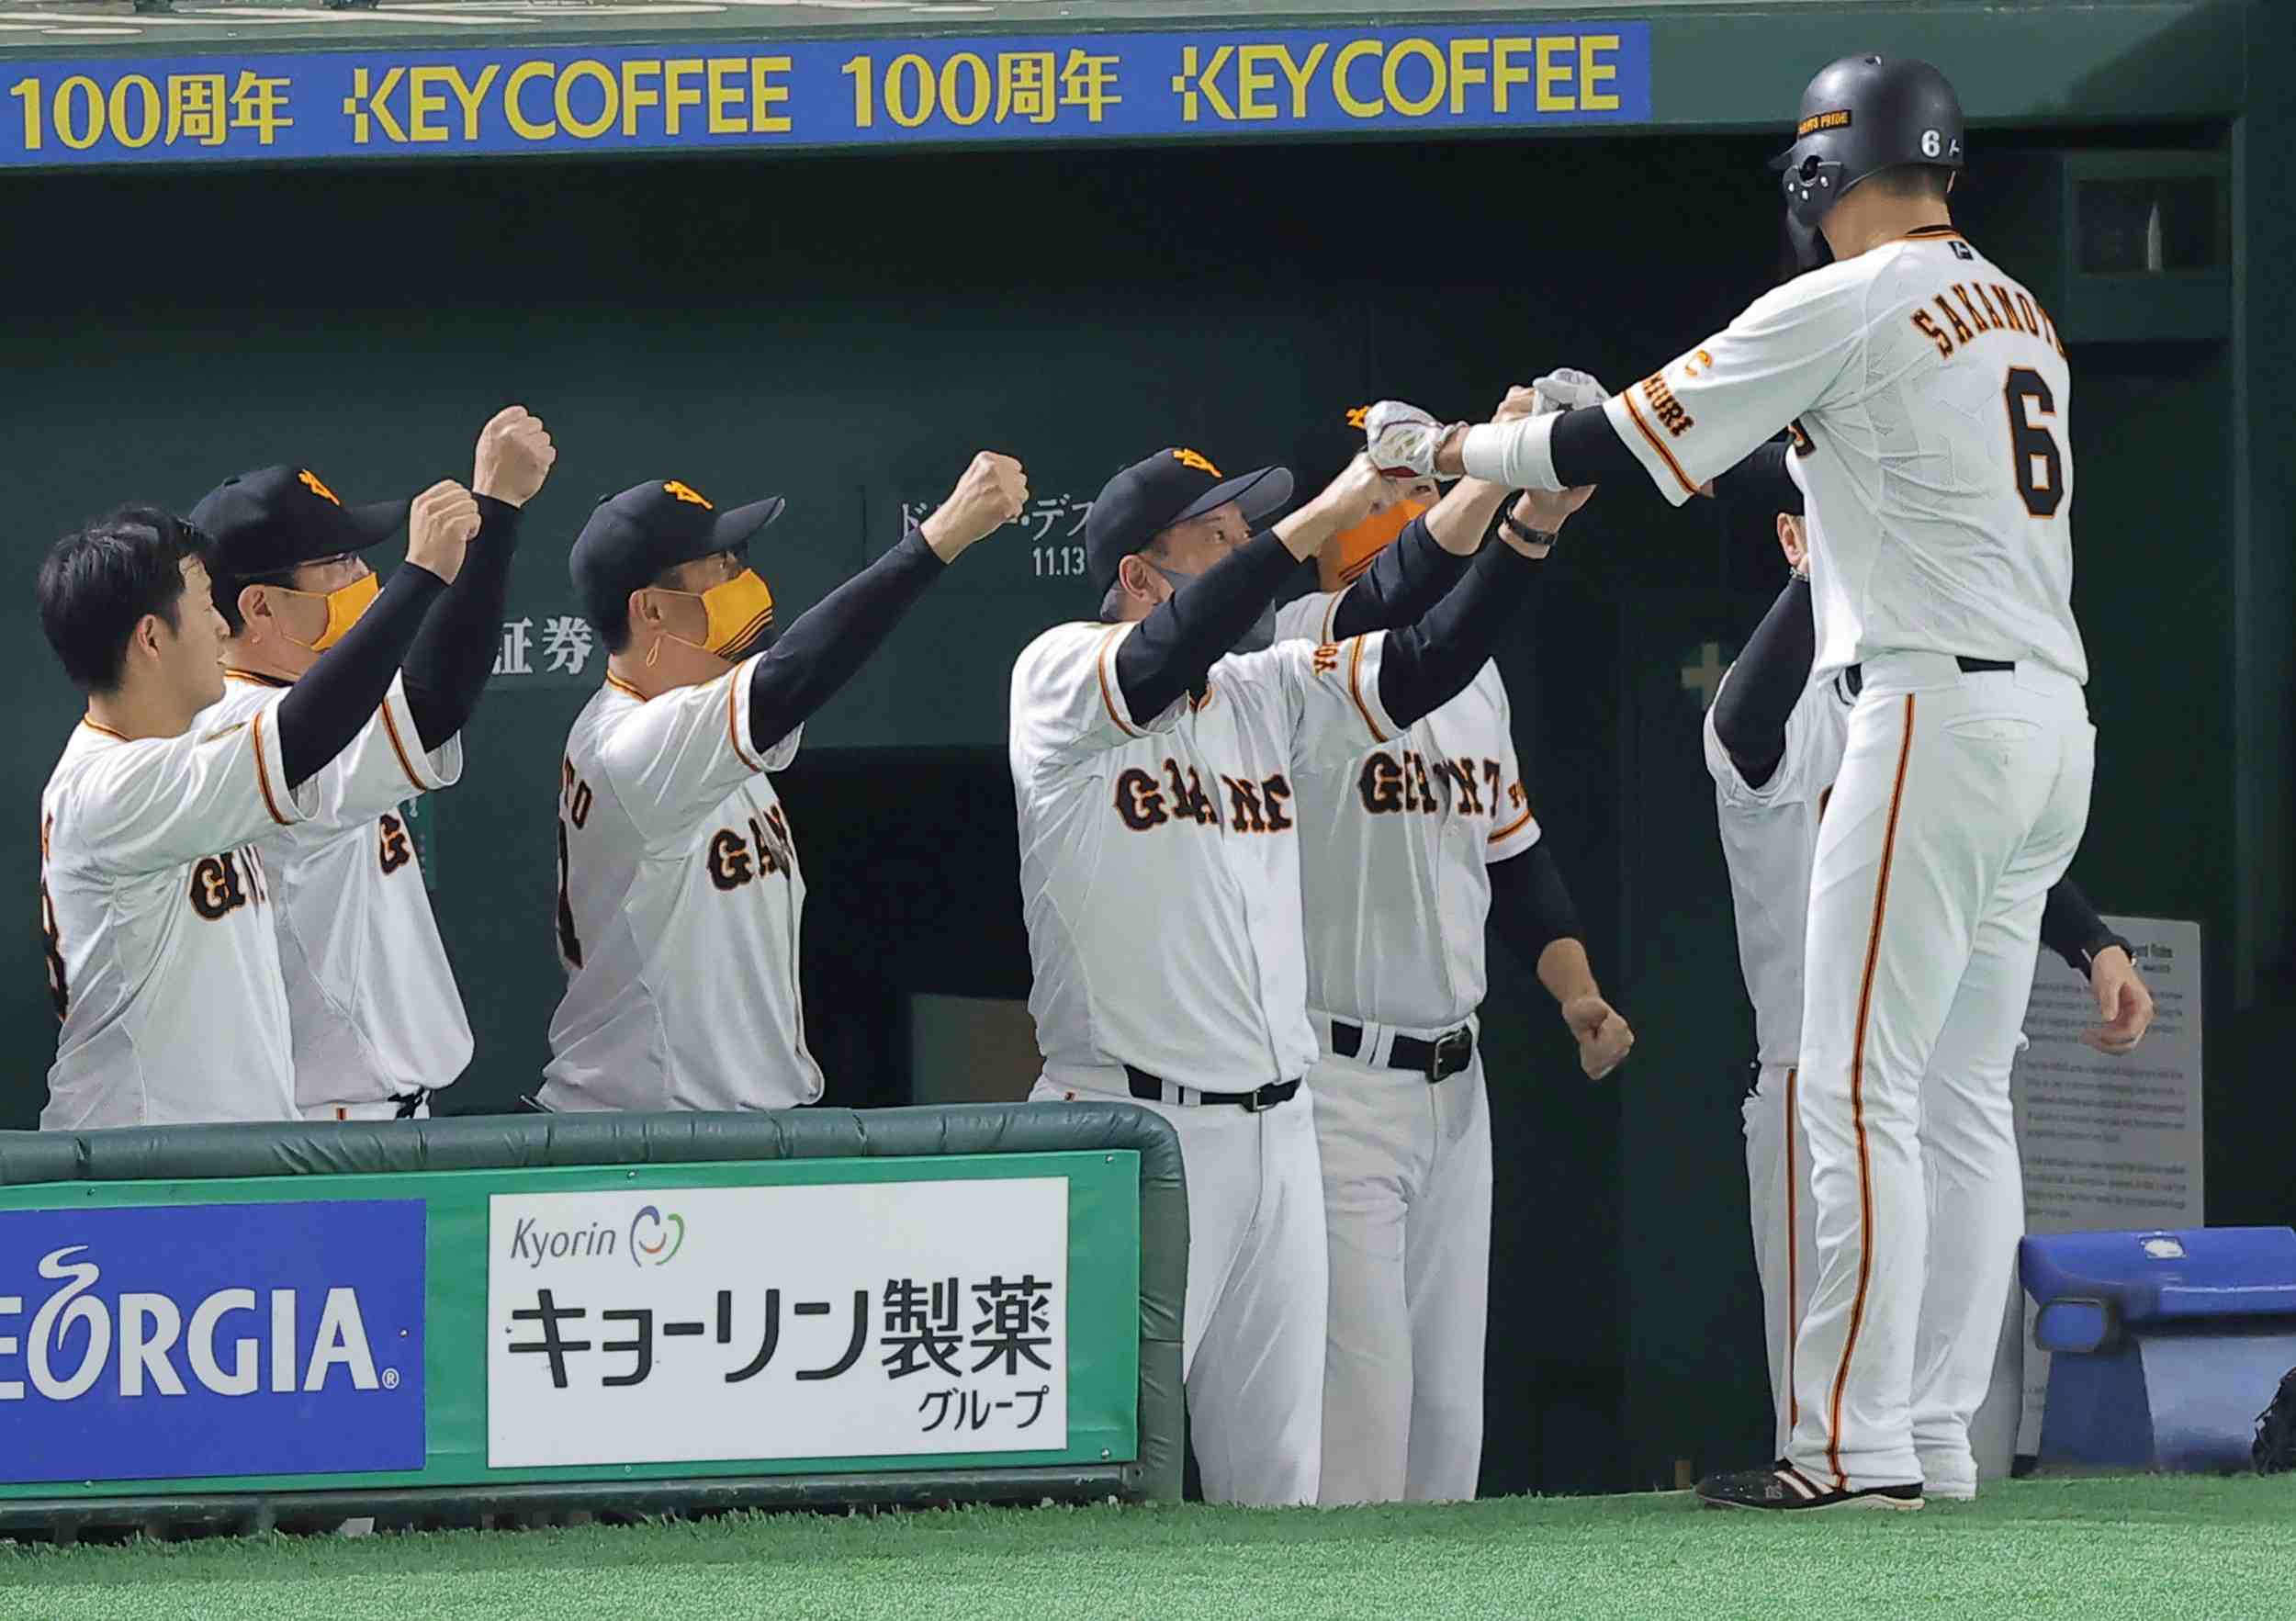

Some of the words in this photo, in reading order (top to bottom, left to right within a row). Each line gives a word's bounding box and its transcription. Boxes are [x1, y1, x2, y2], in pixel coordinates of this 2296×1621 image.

[9, 70, 294, 150] 100周年
[840, 49, 1122, 128] 100周年
[1921, 129, 1941, 158] 6
[2004, 366, 2065, 519] 6
[1032, 546, 1086, 577] 11.13
[510, 1218, 616, 1268] Kyorin
[508, 1274, 1053, 1390] キョーリン製薬
[917, 1384, 1051, 1433] グループ
